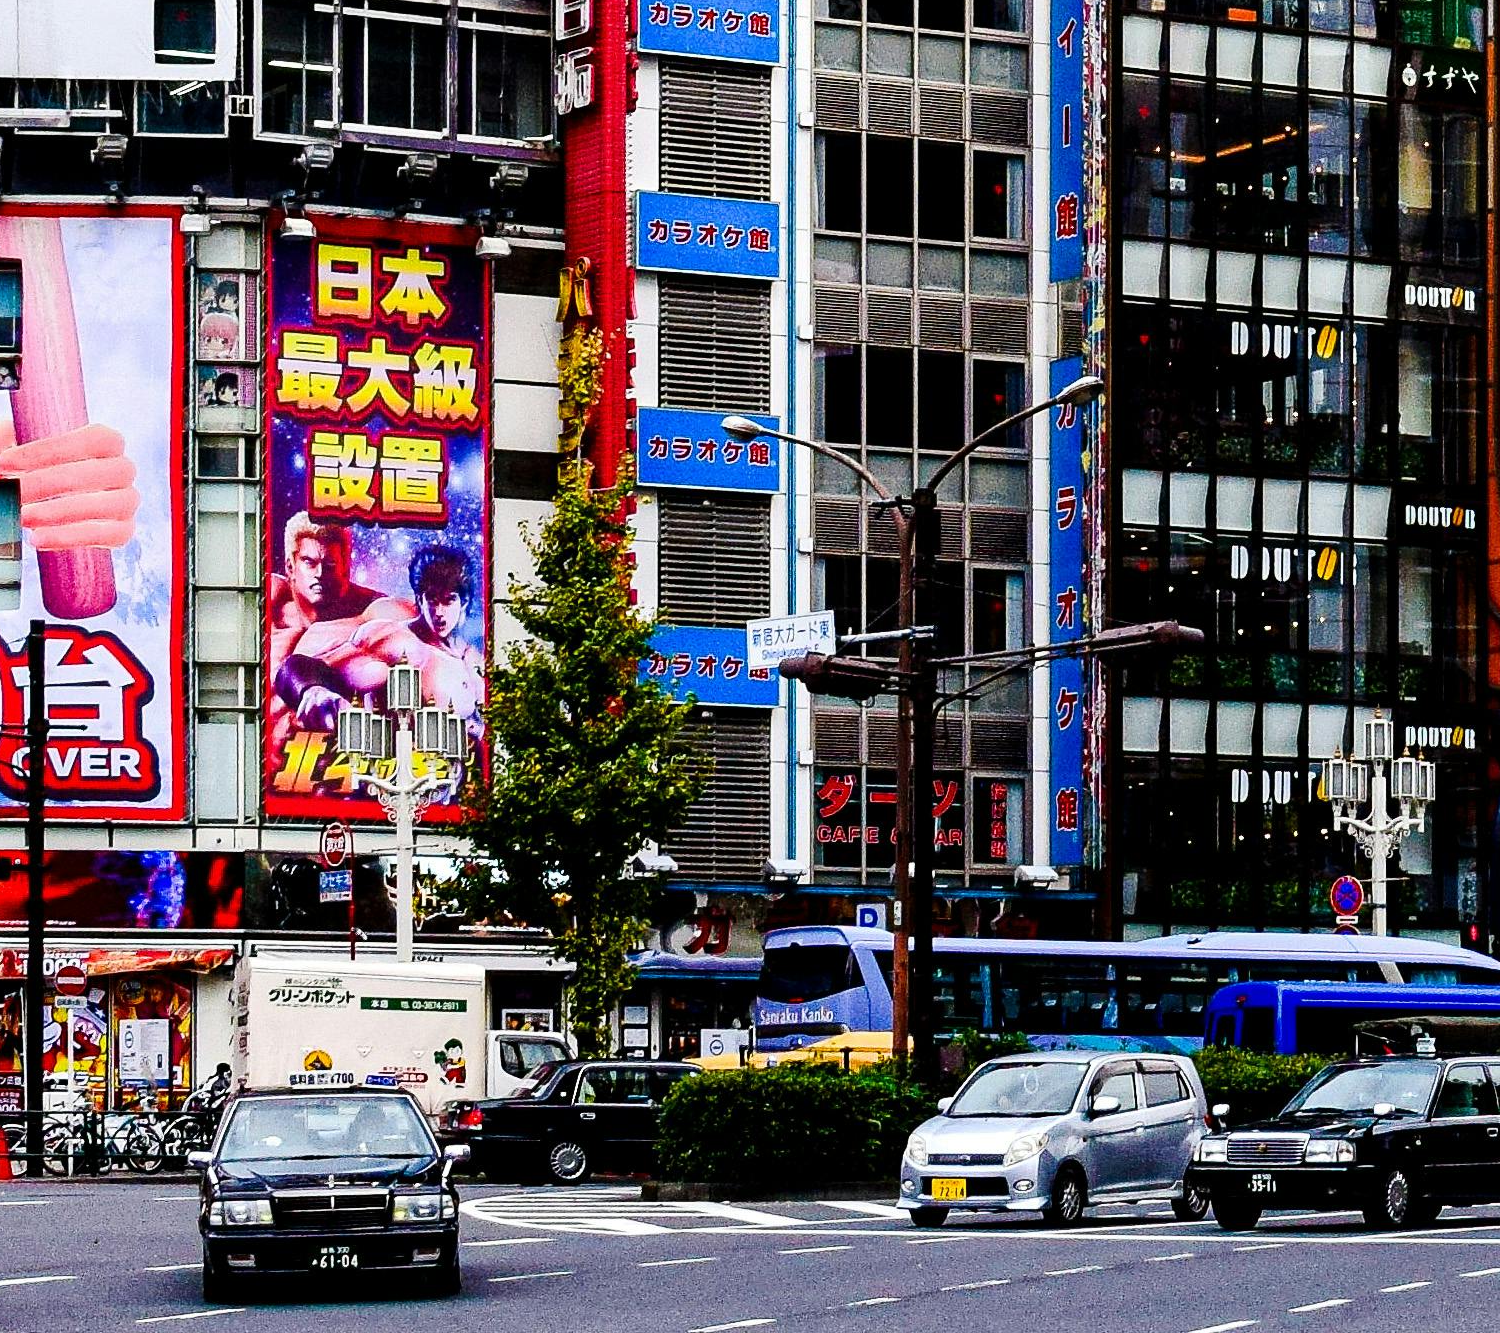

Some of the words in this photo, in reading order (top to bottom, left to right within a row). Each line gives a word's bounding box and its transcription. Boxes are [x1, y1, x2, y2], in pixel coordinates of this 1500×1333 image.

[649, 1, 771, 37] カラオケ館
[648, 219, 771, 252] カラオケ館
[317, 243, 447, 325] 日本
[1404, 285, 1476, 312] DOUTOR
[277, 332, 479, 420] 最大級
[648, 434, 771, 467] カラオケ館
[310, 432, 444, 514] 設置
[1404, 505, 1476, 530] DOUTOR
[817, 826, 879, 844] CAFE
[268, 989, 355, 1005] グリーンポケット
